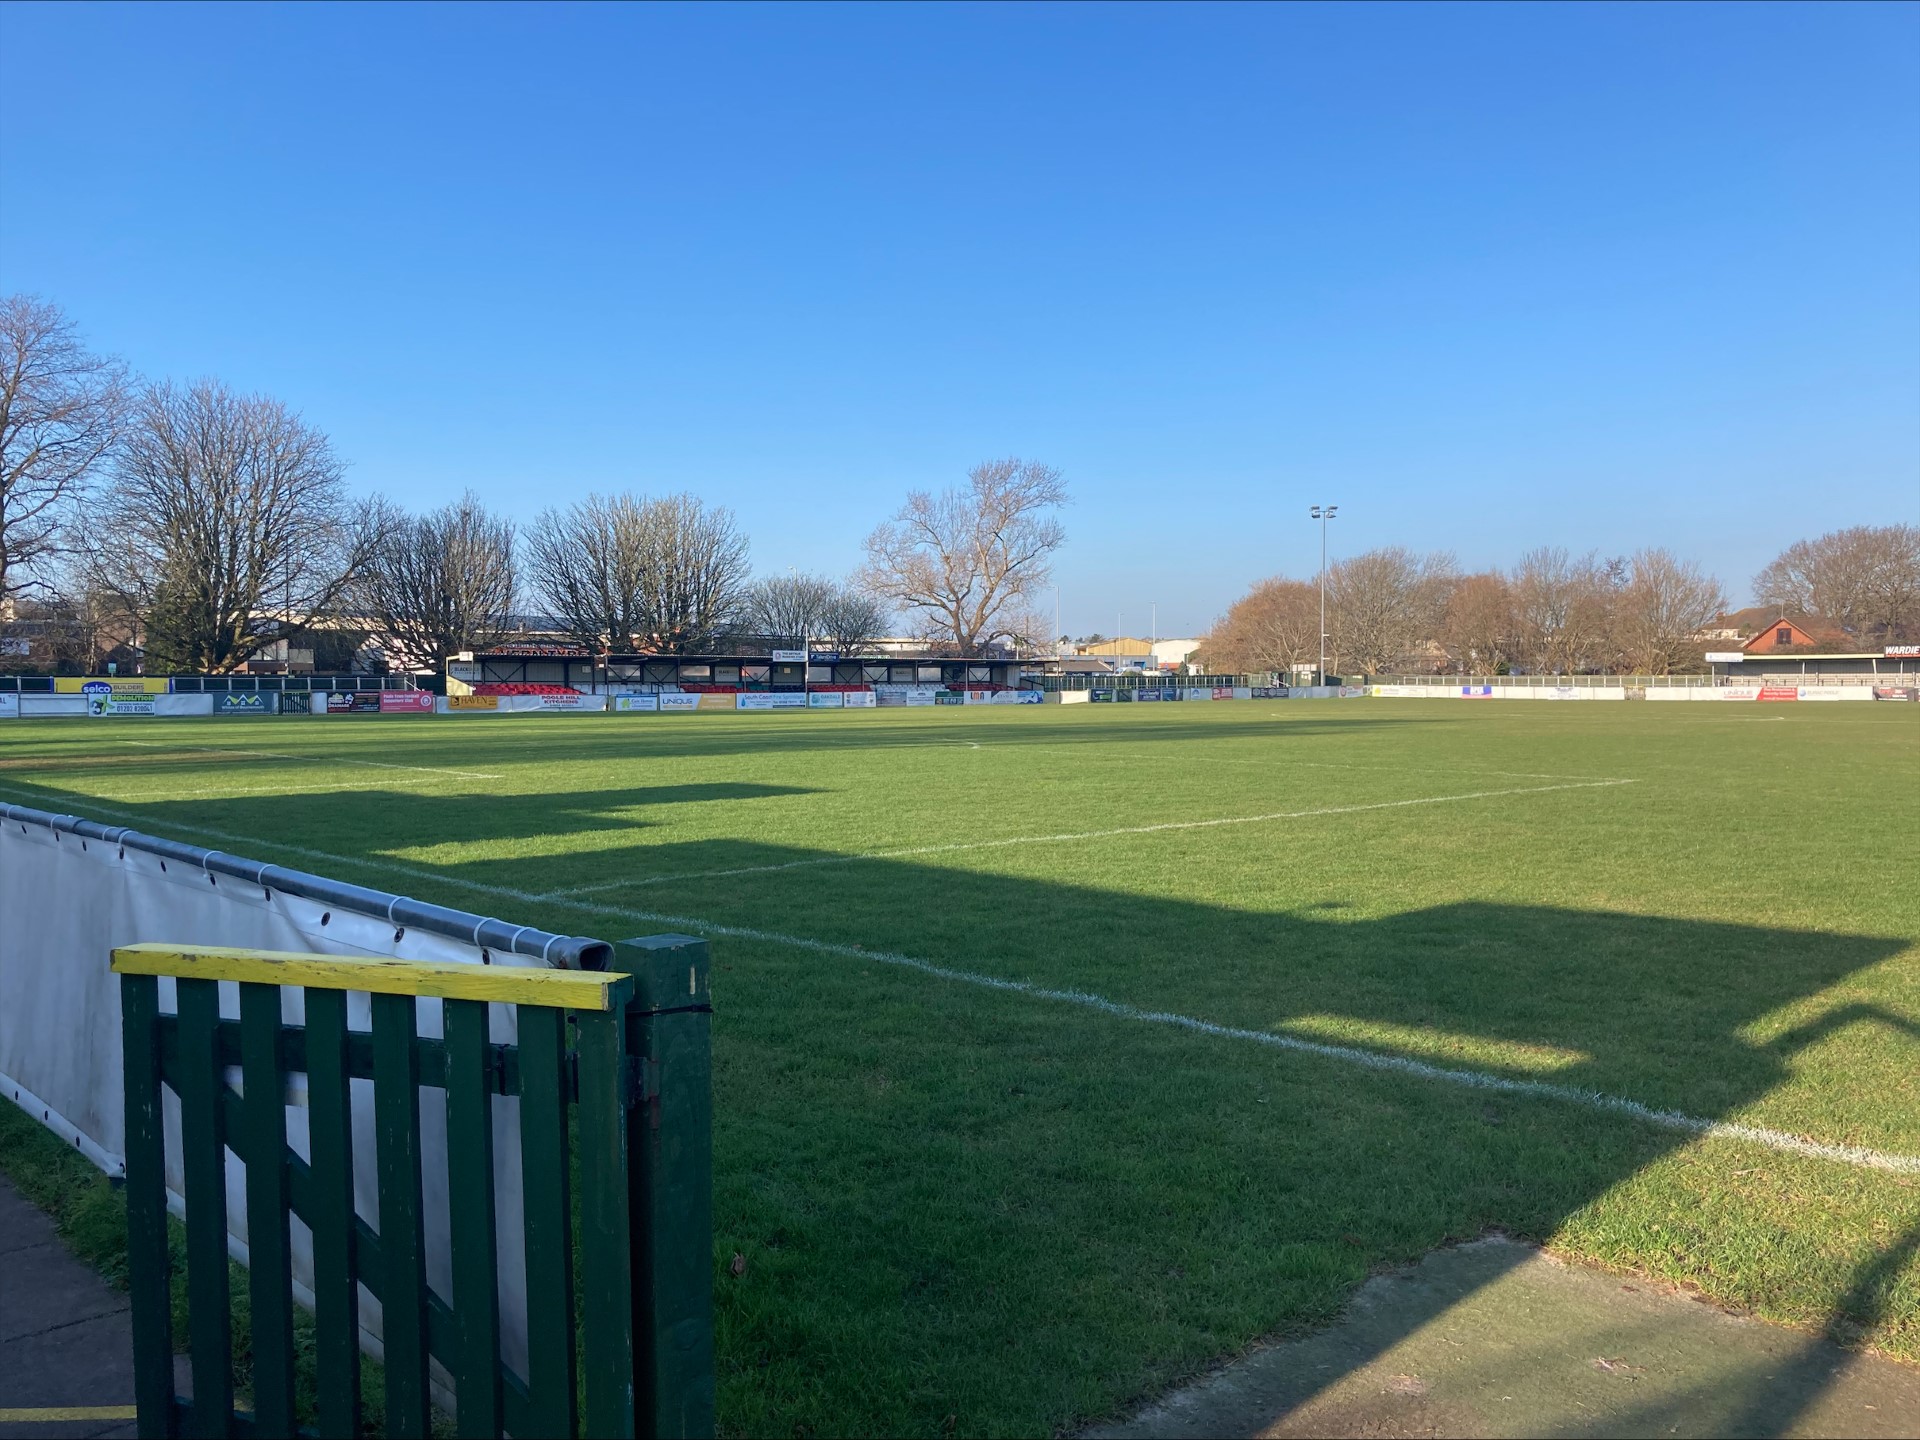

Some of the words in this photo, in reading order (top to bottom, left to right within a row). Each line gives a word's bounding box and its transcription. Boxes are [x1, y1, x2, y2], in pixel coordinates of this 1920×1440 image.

[83, 684, 111, 693] selco
[461, 696, 488, 704] HAVEN
[970, 691, 985, 700] LMA
